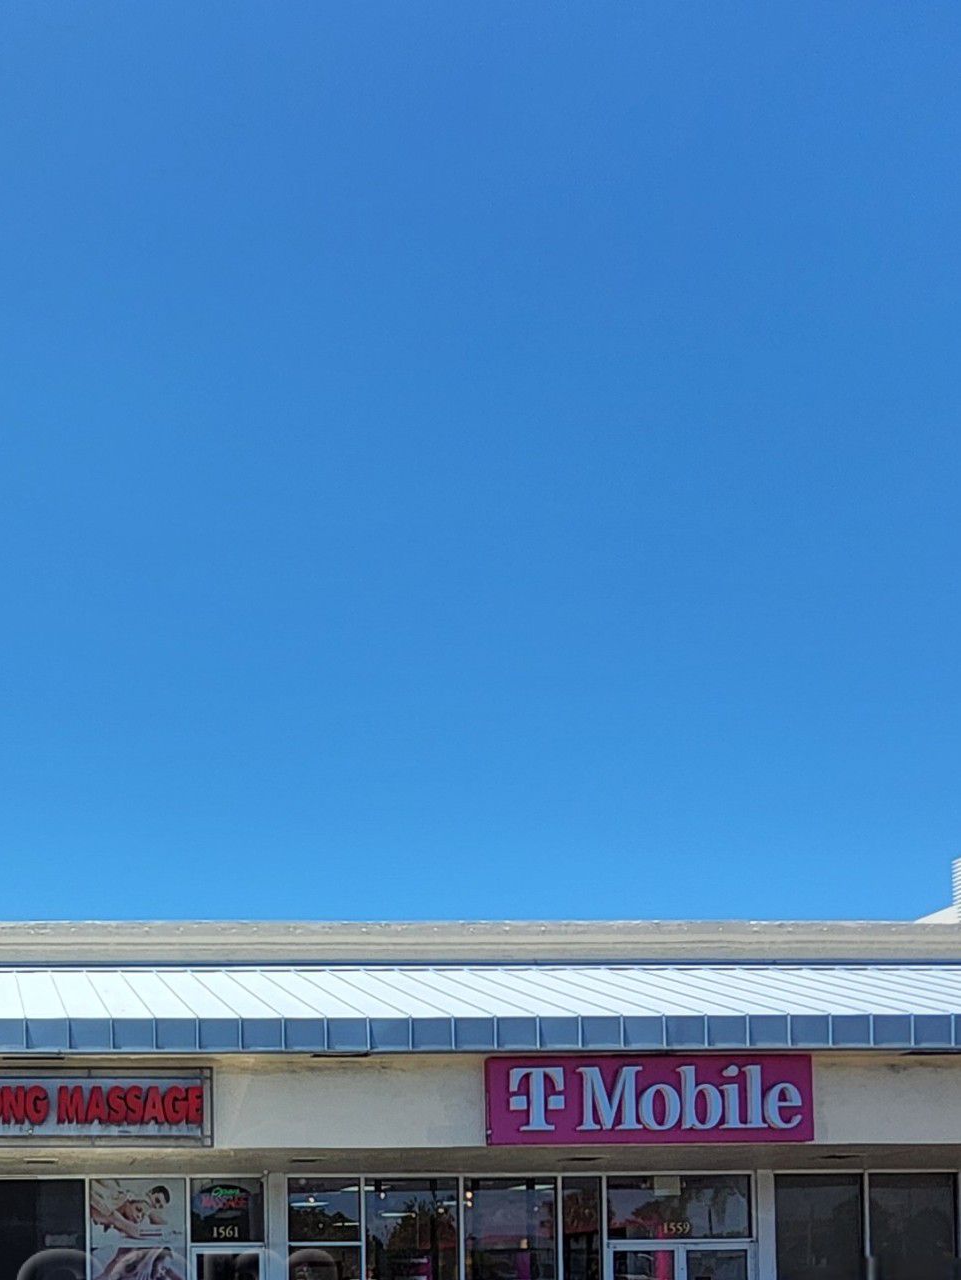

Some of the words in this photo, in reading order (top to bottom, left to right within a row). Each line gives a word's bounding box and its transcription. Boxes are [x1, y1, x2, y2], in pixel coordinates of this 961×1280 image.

[57, 1085, 203, 1126] MASSAGE
[213, 1225, 239, 1239] 1561
[663, 1222, 691, 1234] 1559
